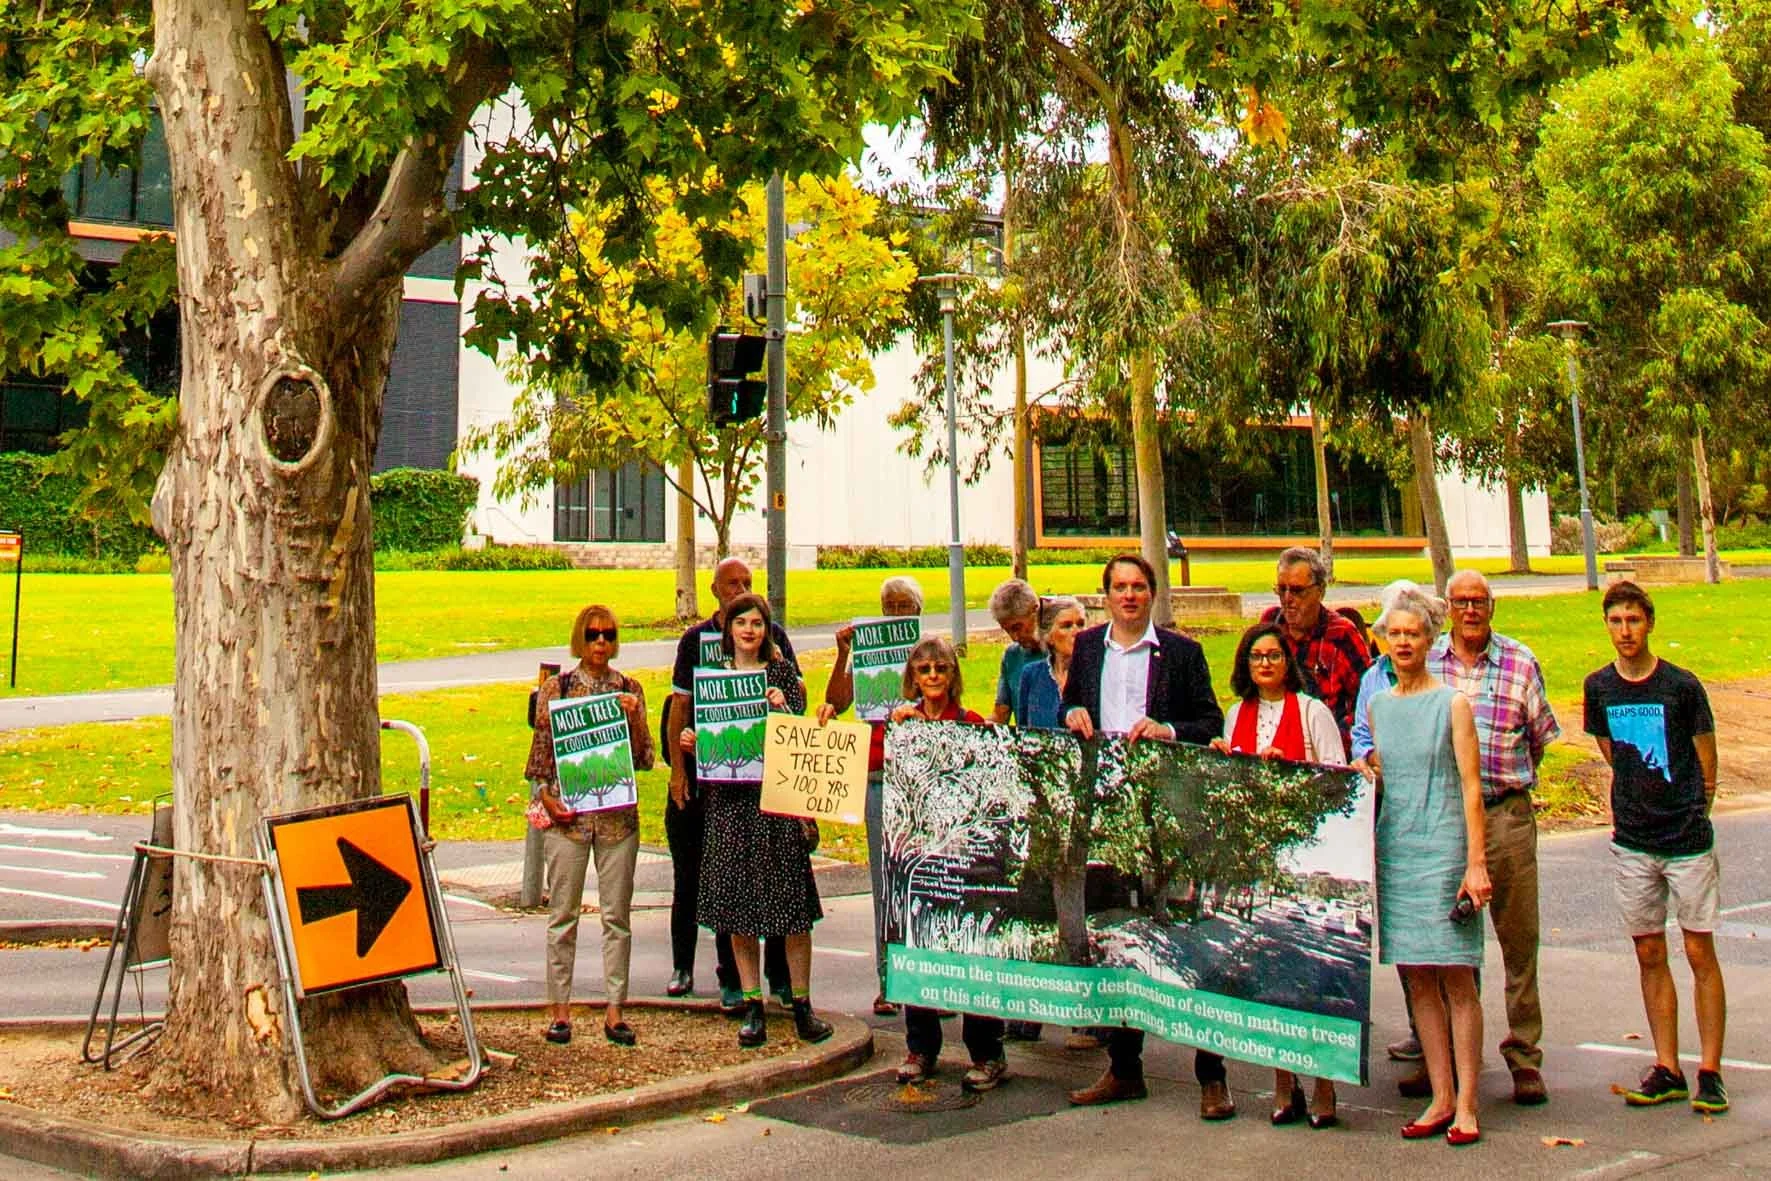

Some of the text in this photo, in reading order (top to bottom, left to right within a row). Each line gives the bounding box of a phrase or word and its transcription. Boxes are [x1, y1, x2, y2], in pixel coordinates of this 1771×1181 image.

[856, 621, 917, 646] MORE TREES
[698, 675, 763, 700] MORE TREES
[554, 698, 621, 732] MORE TREES
[1608, 706, 1637, 719] HEAPS
[775, 724, 857, 755] SAVE OUR
[790, 752, 847, 775] TREES
[828, 780, 849, 798] YRS
[806, 796, 840, 814] OLD!
[891, 954, 1357, 1048] We mourn the unnecessary destruction of eleven mature trees
[921, 987, 939, 1001] on
[943, 986, 969, 1005] this
[1007, 999, 1025, 1013] on
[1029, 999, 1105, 1021] Saturday
[1171, 1020, 1194, 1039] 5th
[1196, 1027, 1213, 1043] of
[1213, 1031, 1276, 1059] October
[1278, 1049, 1319, 1069] 2019.
